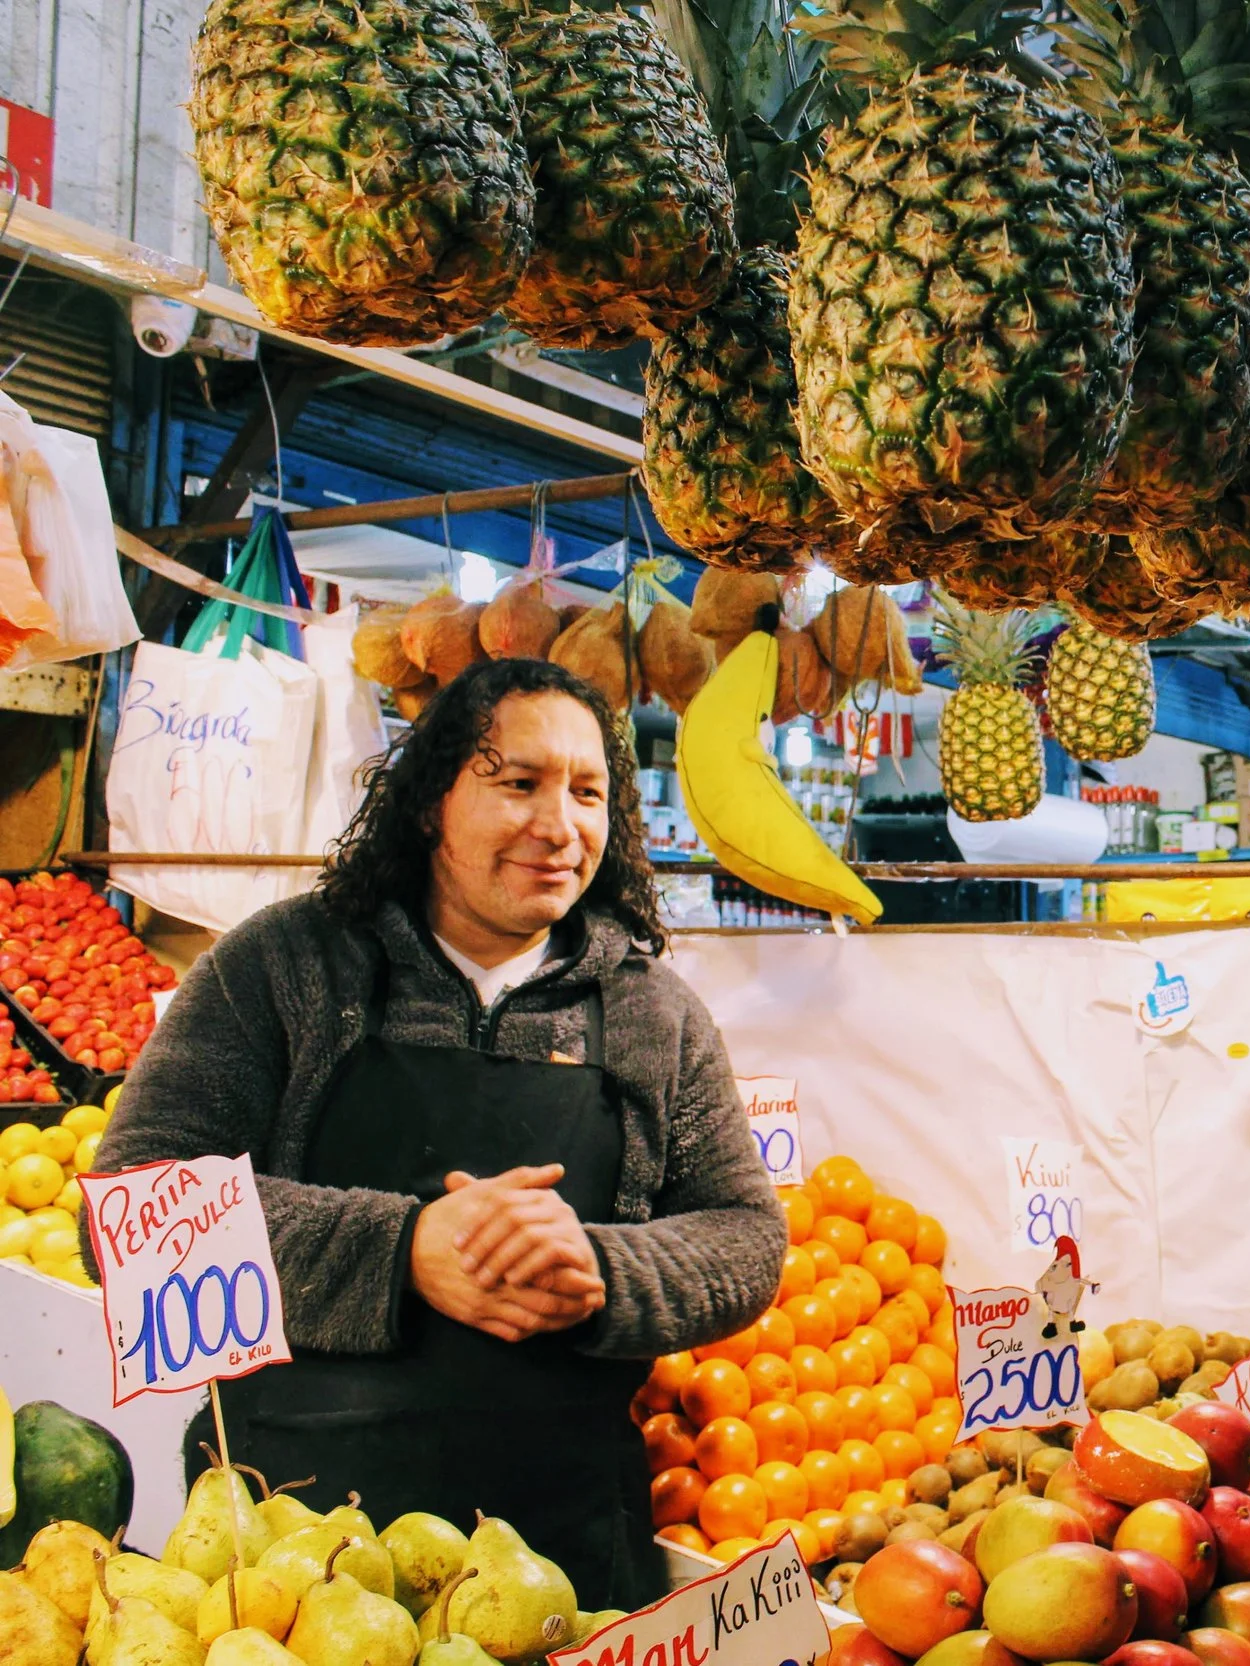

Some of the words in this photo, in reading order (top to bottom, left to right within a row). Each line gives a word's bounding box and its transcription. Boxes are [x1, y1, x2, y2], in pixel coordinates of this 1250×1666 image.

[1015, 1143, 1071, 1188] Kiwi
[157, 1176, 244, 1274] DULCE
[1028, 1193, 1083, 1245] 800
[955, 1297, 1030, 1347] Mango
[248, 1344, 272, 1361] KILO
[981, 1338, 1024, 1363] Dulce
